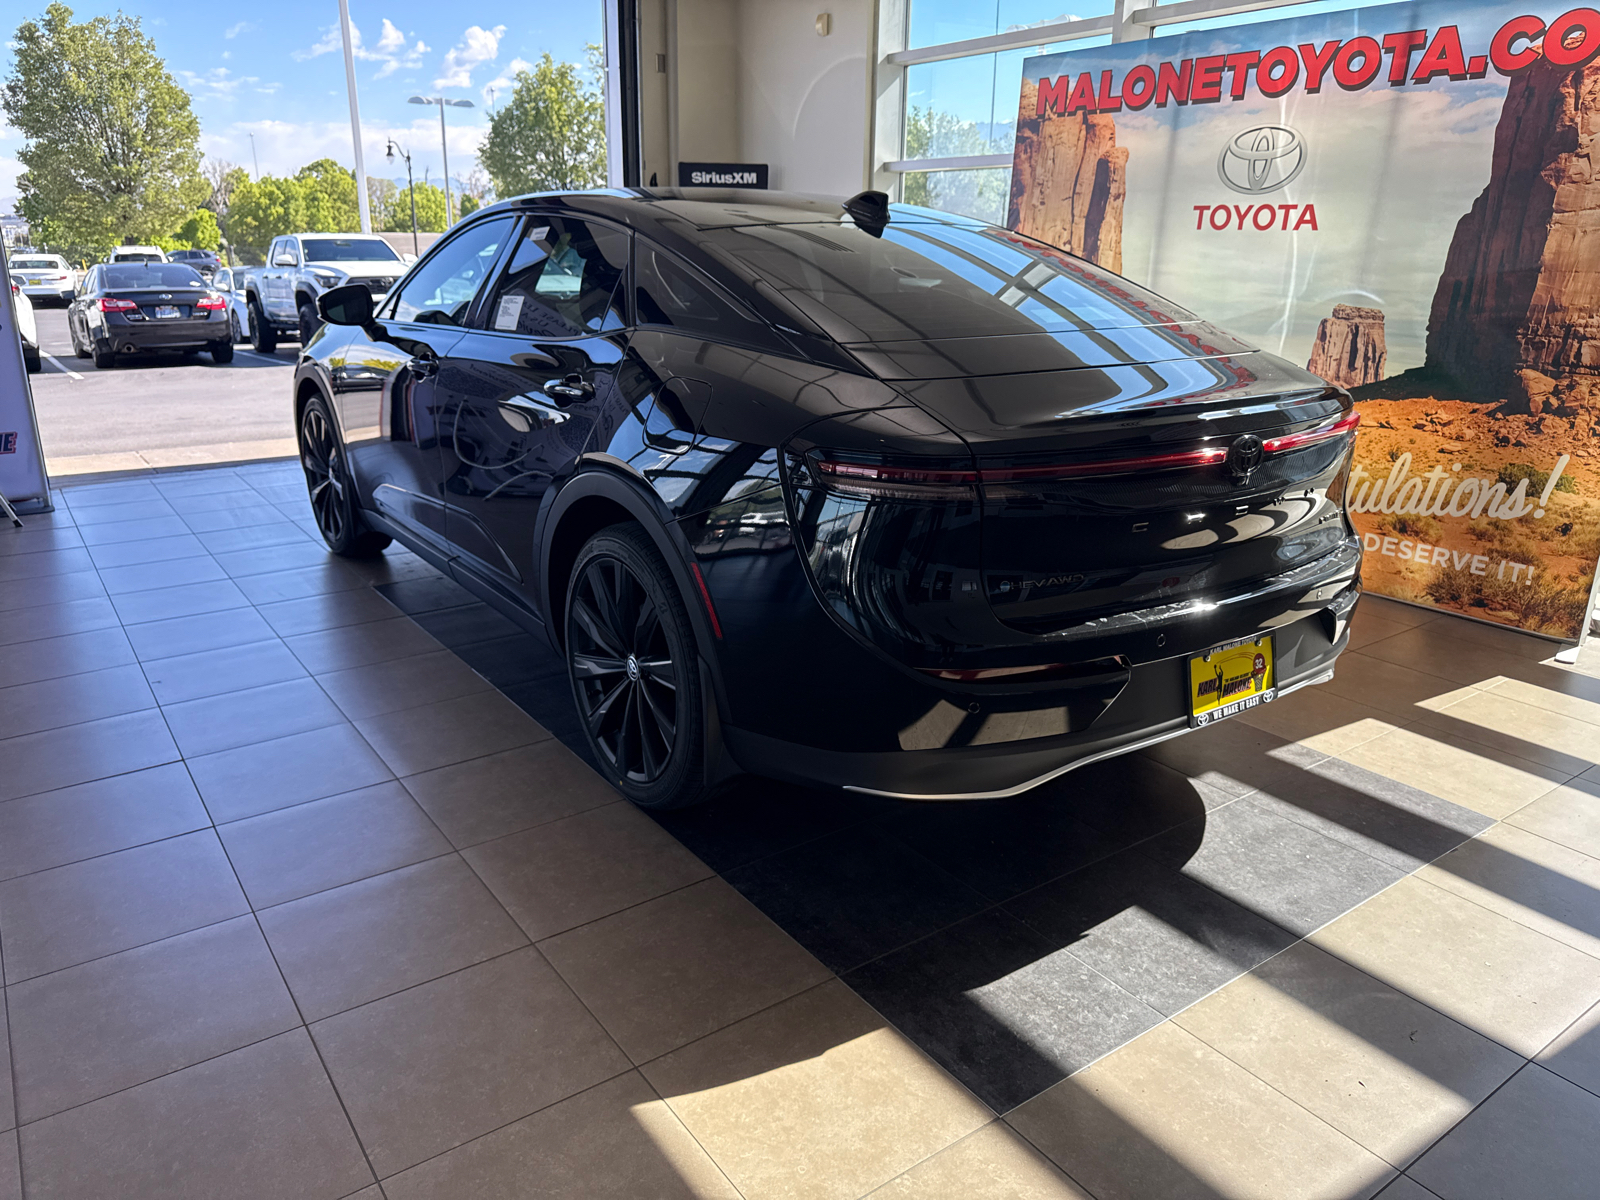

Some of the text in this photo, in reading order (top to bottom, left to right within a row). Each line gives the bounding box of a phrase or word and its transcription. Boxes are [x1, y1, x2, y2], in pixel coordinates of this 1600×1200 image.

[691, 171, 757, 184] SiriusXM
[1193, 203, 1319, 232] TOYOTA
[1363, 533, 1535, 586] DESERVE IT!
[1255, 658, 1263, 669] 32
[1197, 678, 1218, 698] KARL
[1212, 709, 1223, 720] WE
[1223, 703, 1239, 716] MAKE
[1239, 701, 1246, 711] IT
